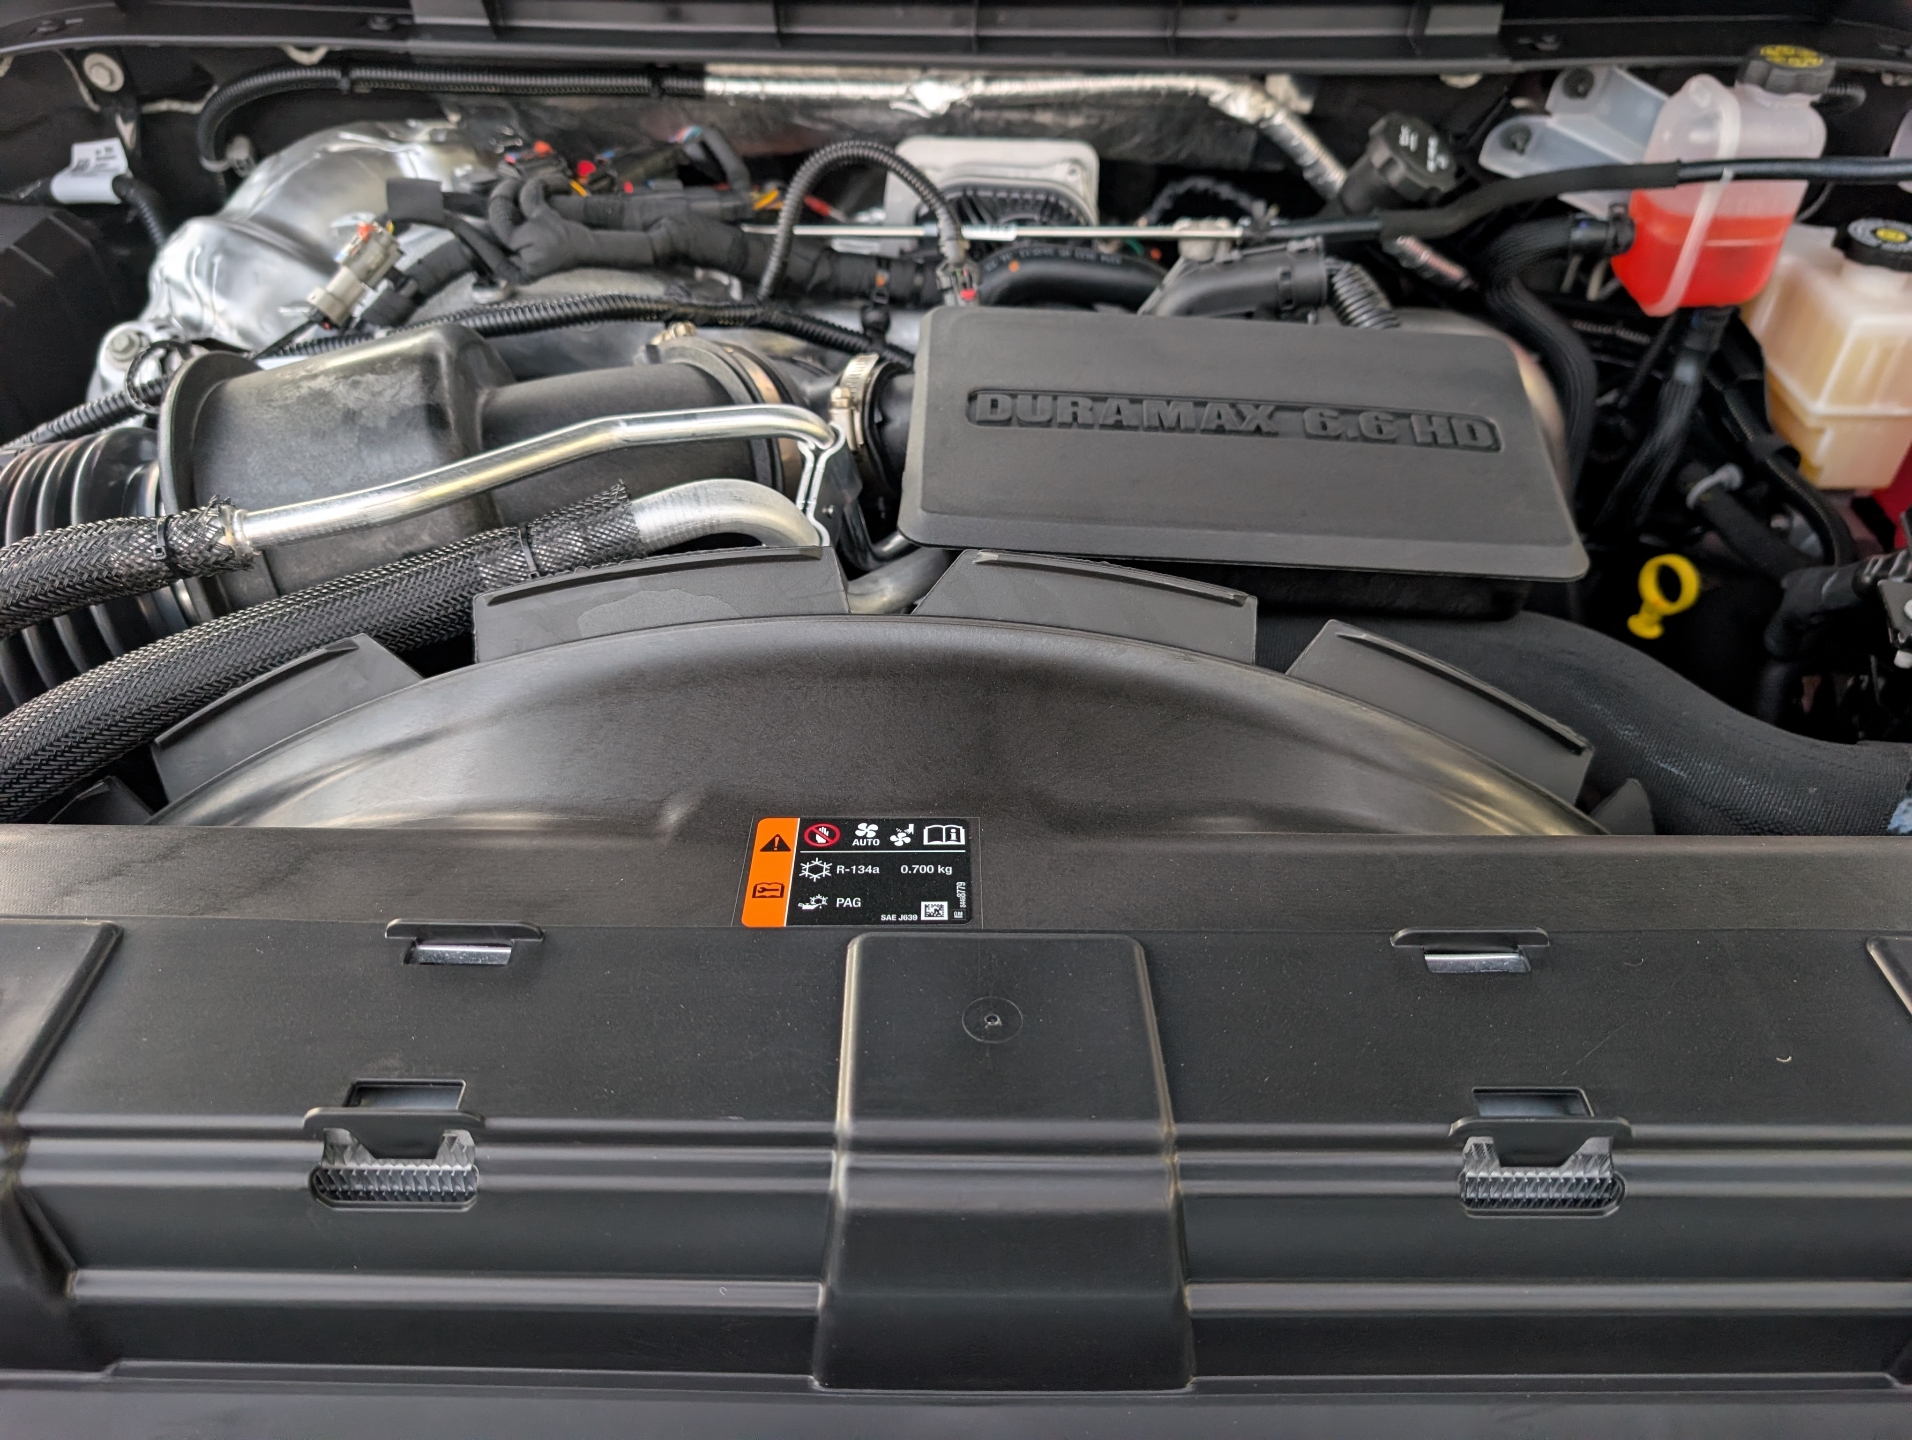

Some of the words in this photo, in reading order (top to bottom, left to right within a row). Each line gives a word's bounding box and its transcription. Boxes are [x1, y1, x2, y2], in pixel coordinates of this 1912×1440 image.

[975, 393, 1280, 436] DURAMAX
[1302, 407, 1399, 443] 6.6
[1410, 413, 1498, 450] HD
[852, 838, 880, 846] AUTO
[836, 865, 880, 874] R-134a
[900, 865, 934, 874] 0.700
[937, 865, 953, 875] kg
[836, 898, 861, 908] PAG
